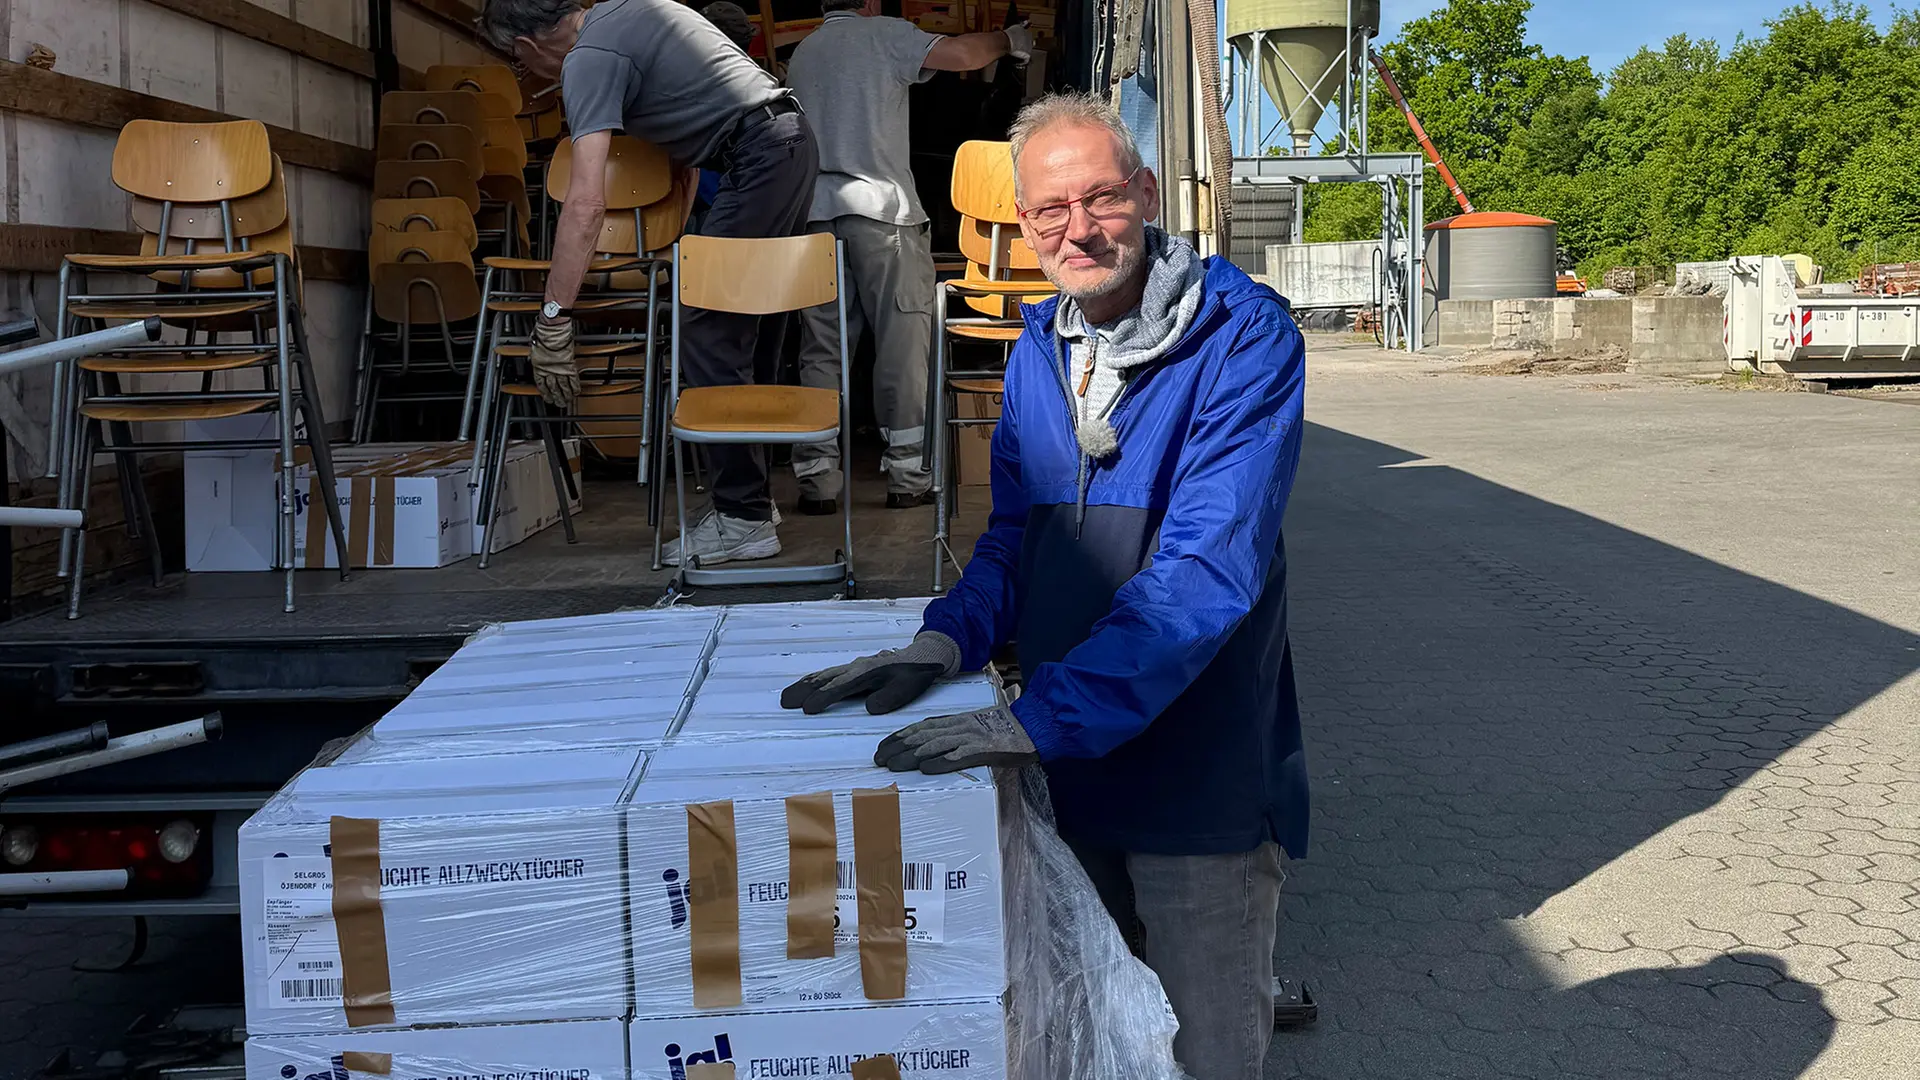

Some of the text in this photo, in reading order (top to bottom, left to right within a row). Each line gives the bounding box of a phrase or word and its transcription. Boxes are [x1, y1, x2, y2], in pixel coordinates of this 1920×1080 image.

[293, 871, 327, 879] SELGROS
[438, 858, 585, 886] ALLZWECKTÜCHER
[280, 882, 317, 890] ÖJENDORF
[904, 907, 918, 930] 5
[799, 993, 807, 1001] 12
[823, 991, 842, 1000] Stück
[750, 1056, 820, 1079] FEUCHTE
